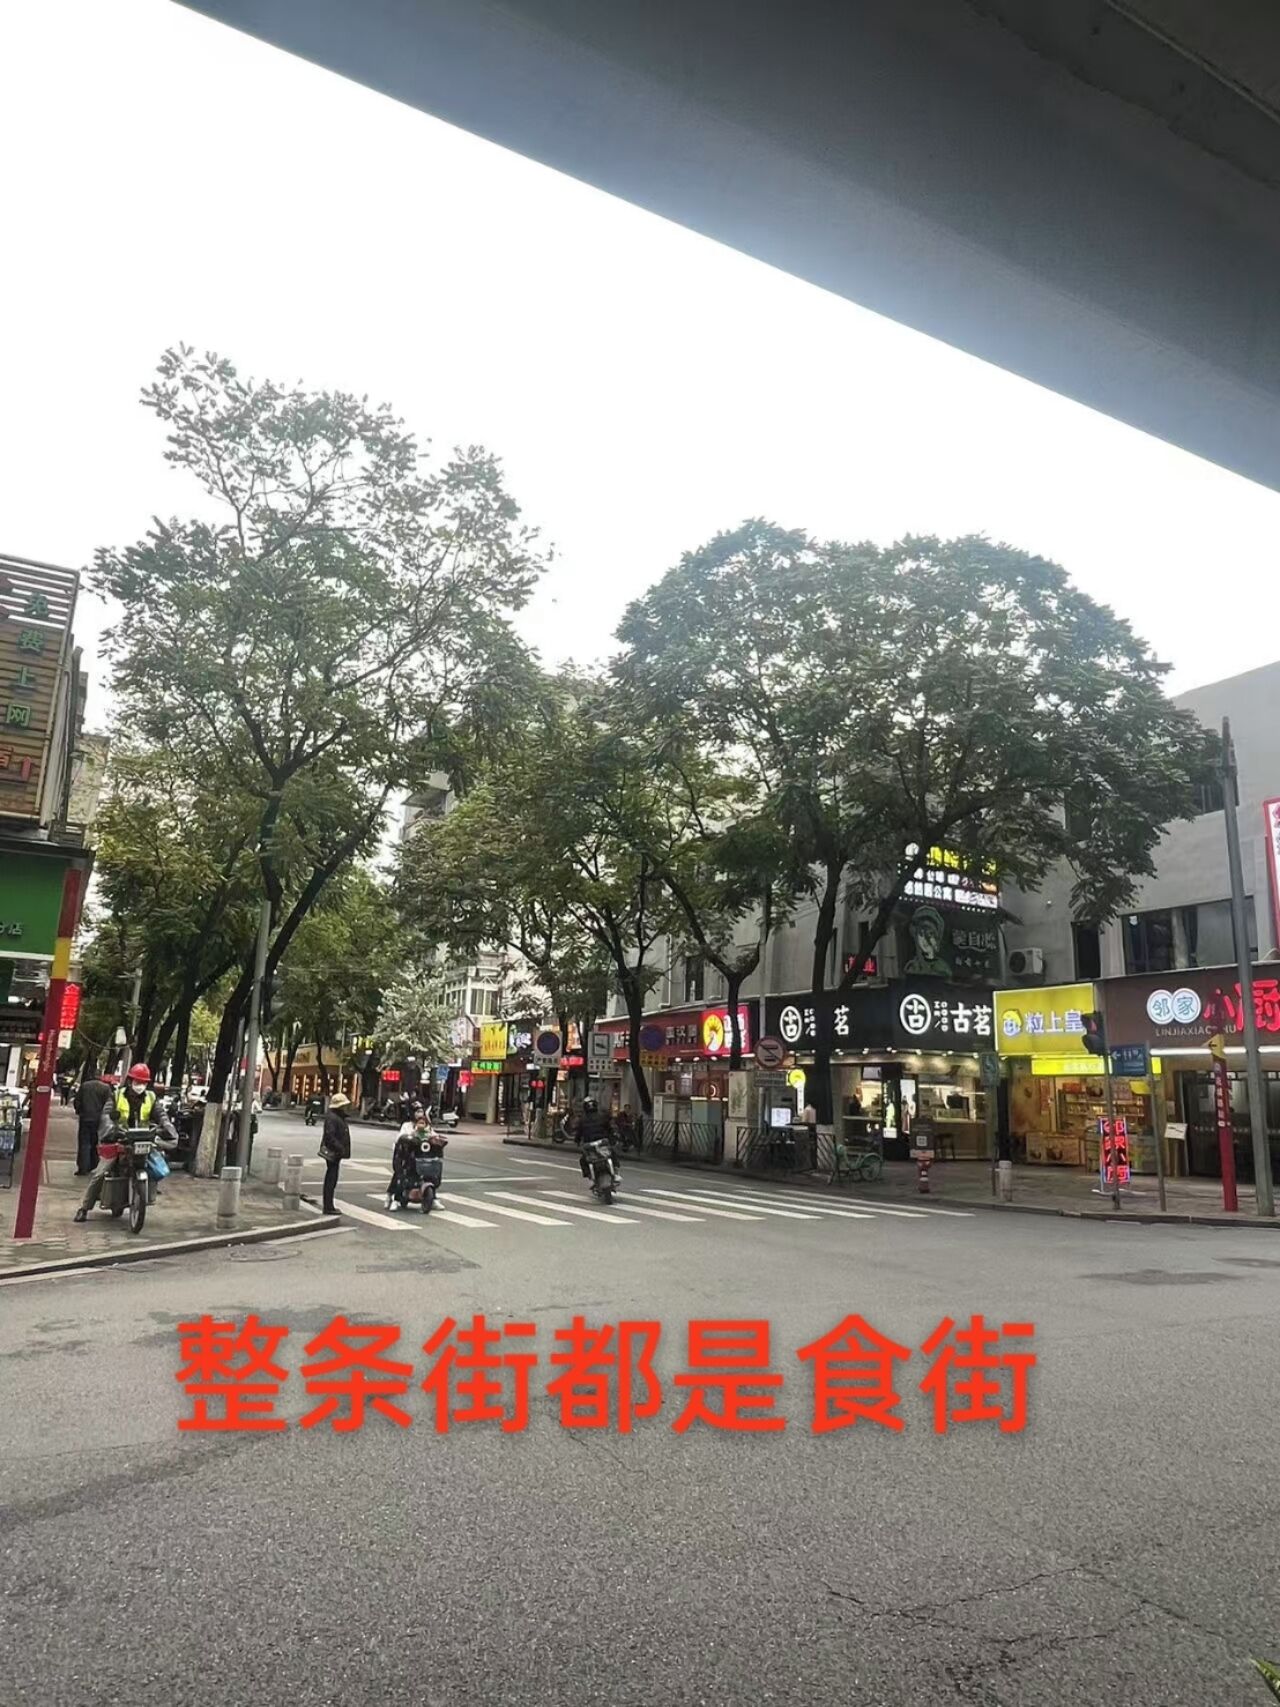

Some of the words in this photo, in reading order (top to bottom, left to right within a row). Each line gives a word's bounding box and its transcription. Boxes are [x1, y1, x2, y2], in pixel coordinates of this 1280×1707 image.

[7, 592, 48, 726] 免费上网
[834, 1005, 849, 1035] 茗
[950, 1002, 992, 1036] 古茗
[1025, 1008, 1085, 1034] 粒上皇
